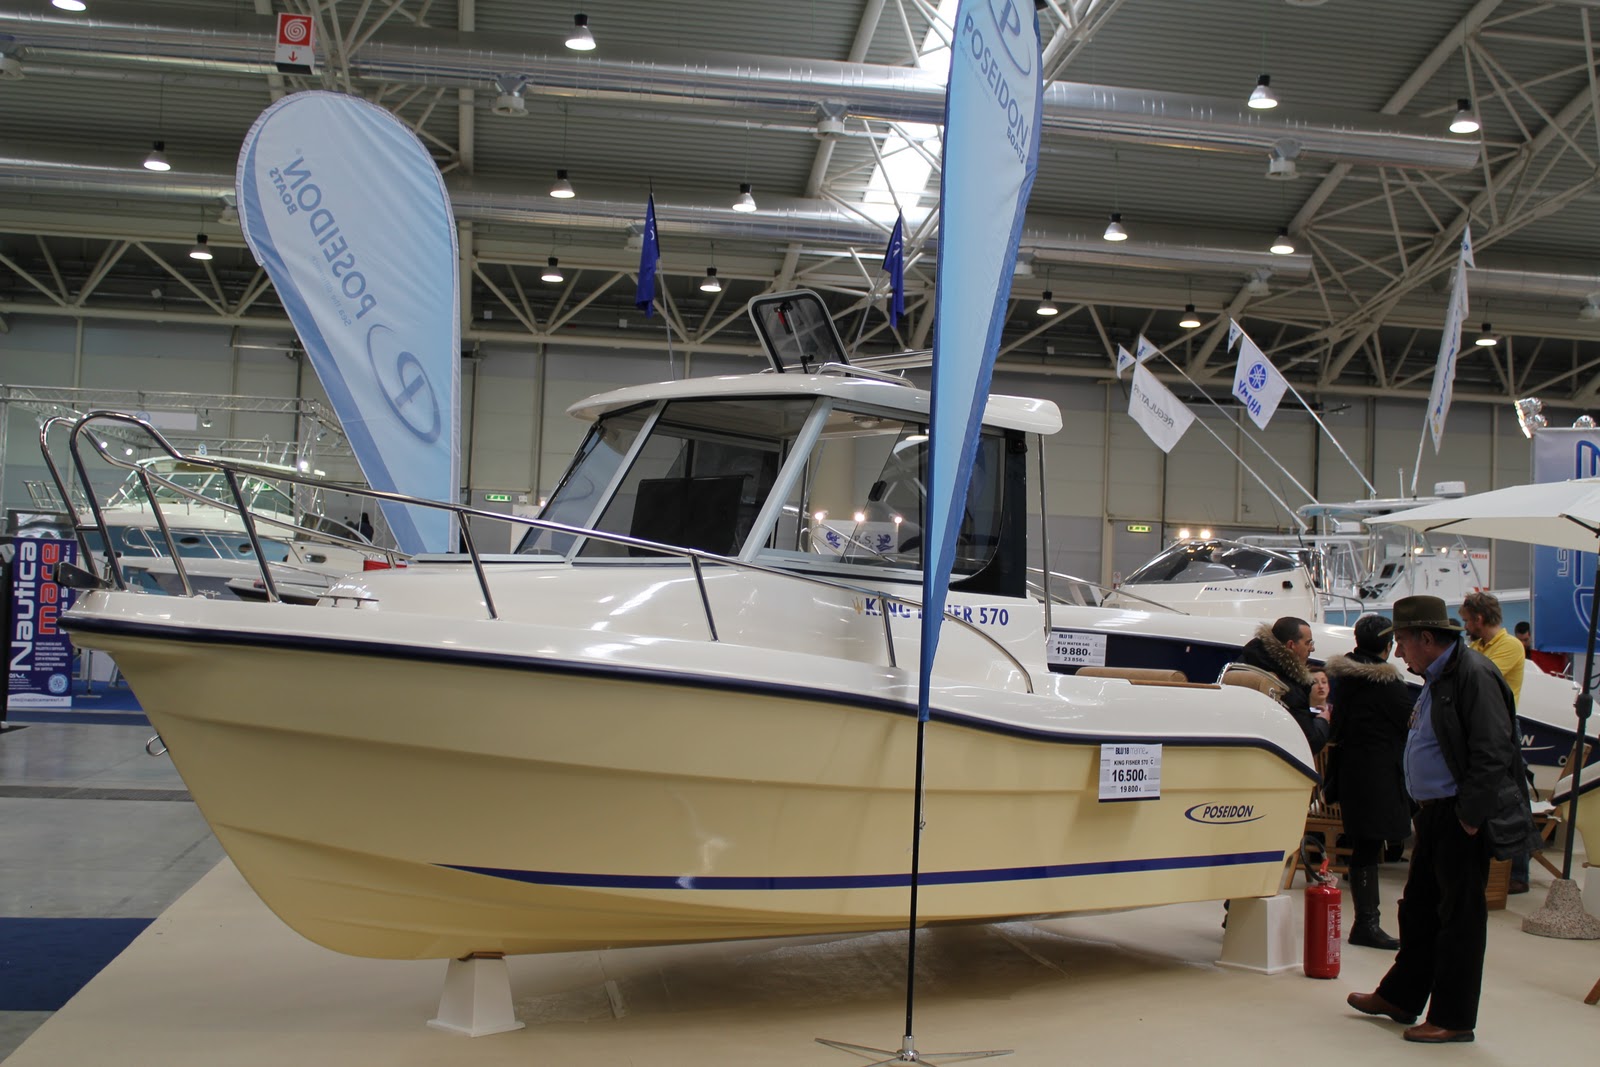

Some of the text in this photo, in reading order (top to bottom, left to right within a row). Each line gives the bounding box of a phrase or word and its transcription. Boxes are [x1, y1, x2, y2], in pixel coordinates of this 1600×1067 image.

[962, 11, 1029, 147] POSEIDON
[1238, 380, 1262, 416] YAAHA
[9, 541, 37, 671] Nautica
[38, 543, 60, 635] mare
[865, 598, 911, 618] KNG
[980, 607, 1009, 626] 570
[1203, 805, 1254, 818] POSEIDON
